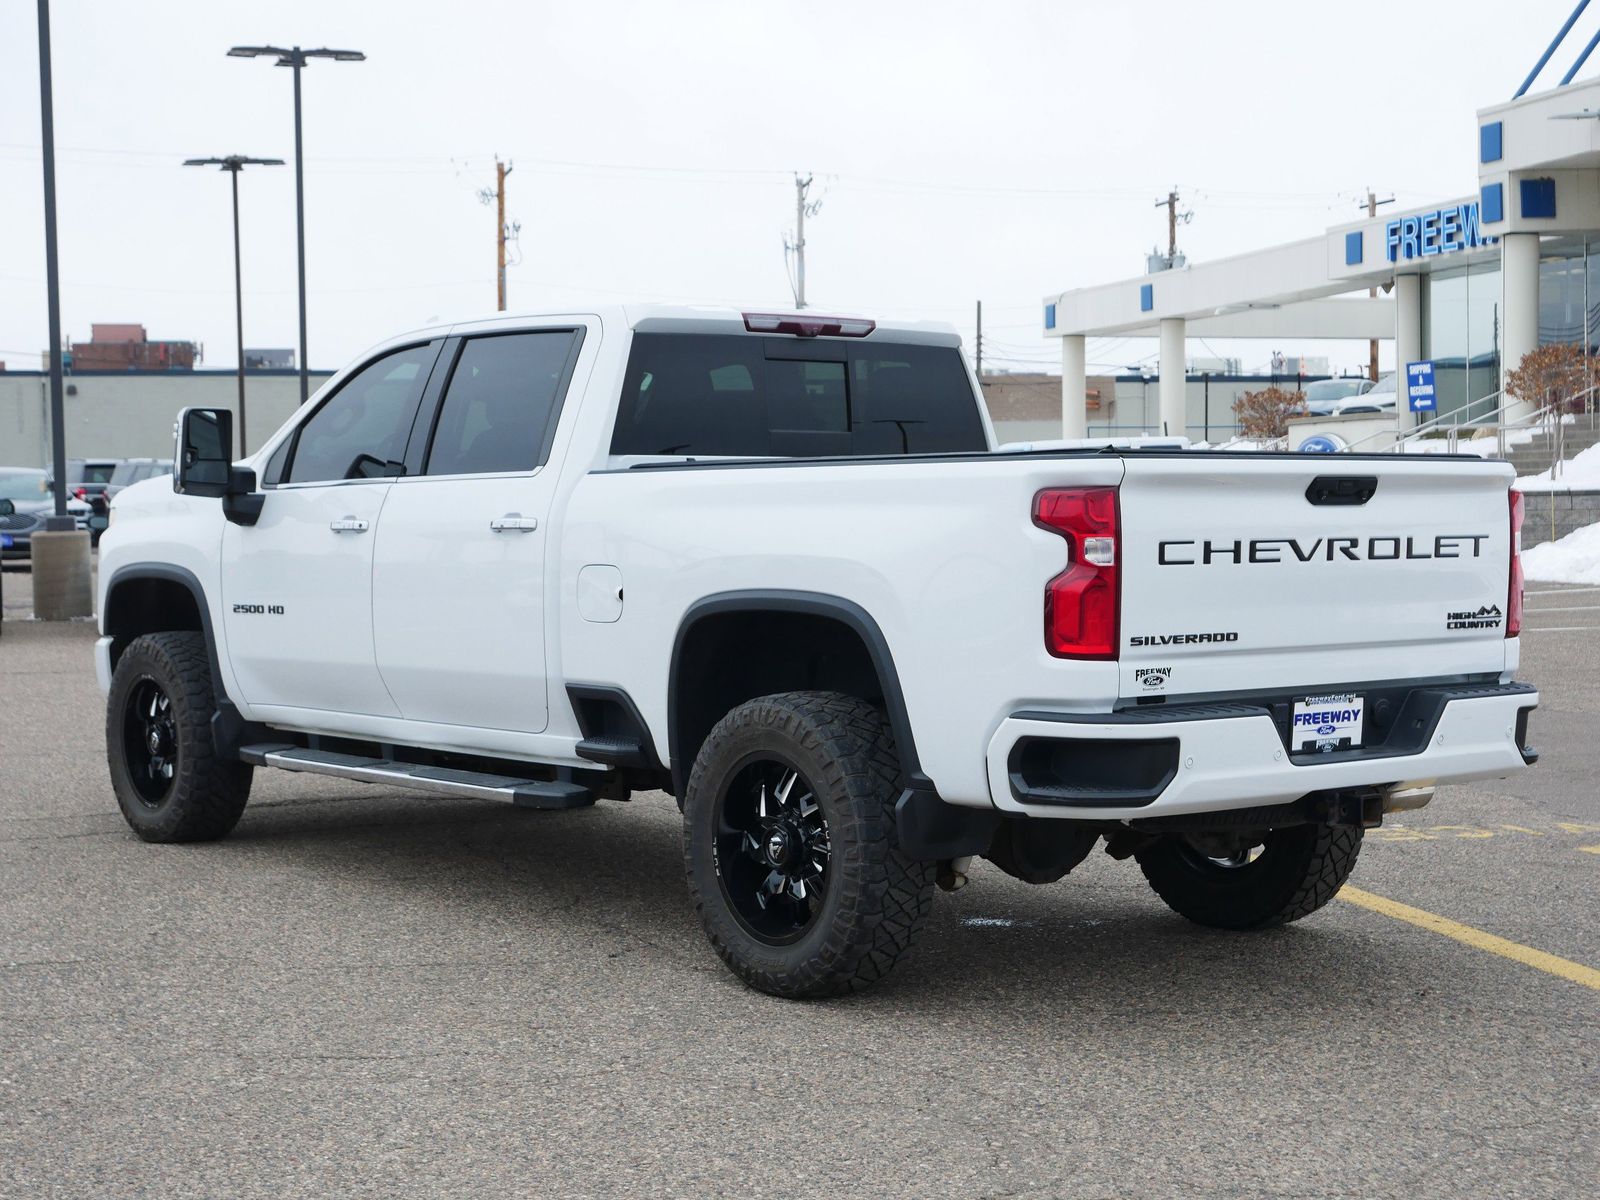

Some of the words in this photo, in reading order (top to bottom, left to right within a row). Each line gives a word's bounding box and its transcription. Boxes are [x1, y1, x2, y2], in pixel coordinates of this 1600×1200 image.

[1386, 202, 1498, 261] FREEW
[1158, 534, 1489, 565] CHEVROLET
[233, 604, 264, 614] 2500
[268, 605, 285, 615] HD
[1447, 611, 1477, 620] HIGH
[1447, 619, 1501, 629] COUNTRY
[1130, 632, 1238, 647] SILVERADO
[1135, 667, 1172, 682] FREEWAY
[1294, 709, 1360, 726] FREEWAY
